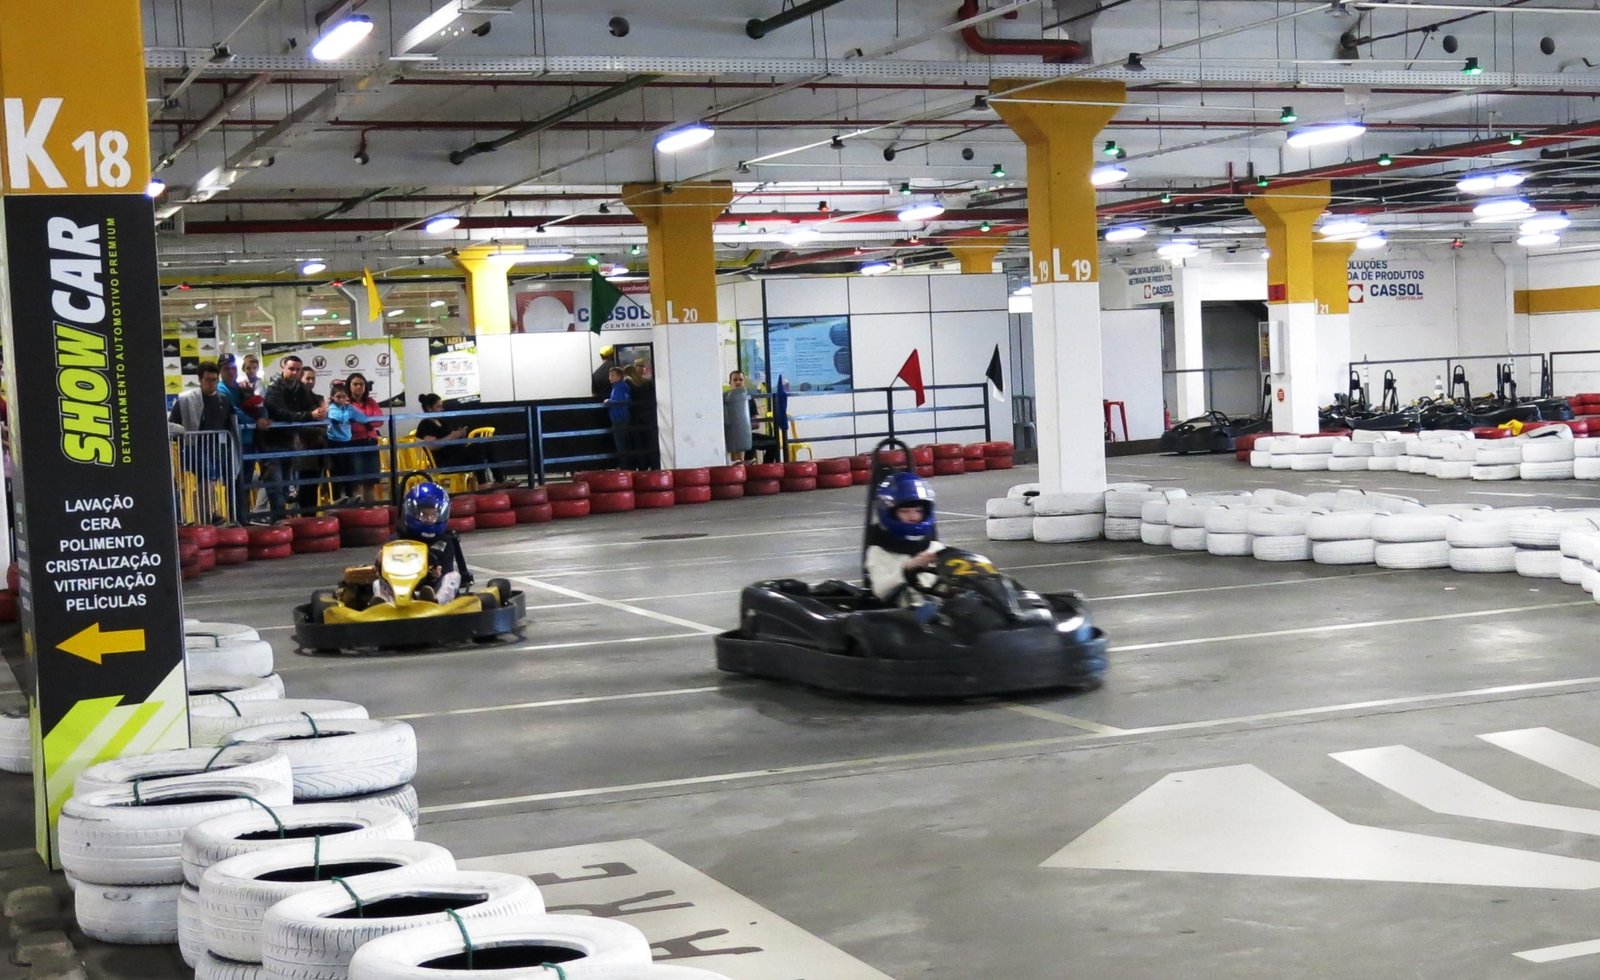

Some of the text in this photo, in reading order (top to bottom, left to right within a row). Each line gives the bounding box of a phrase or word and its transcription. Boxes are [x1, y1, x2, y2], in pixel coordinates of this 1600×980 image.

[4, 97, 132, 189] K 18
[1038, 260, 1049, 282] 19
[1053, 248, 1092, 281] L 19
[1361, 271, 1373, 280] DE
[1375, 270, 1424, 280] PRODUTOS
[1152, 284, 1174, 295] CASSOL
[1370, 283, 1423, 297] CASSOL
[666, 300, 679, 323] L
[683, 308, 698, 323] 20
[106, 217, 132, 464] DETALHAMENTO AUTOMOTIVO PREMIUM
[65, 495, 134, 513] LAVAÇÃO
[80, 517, 122, 531] CERA
[59, 535, 145, 552] POLIMENTO
[45, 552, 162, 574] CRISTALIZAÇÃO
[54, 573, 156, 593] VITRIFICAÇÃO
[66, 593, 147, 611] PELÍCULAS
